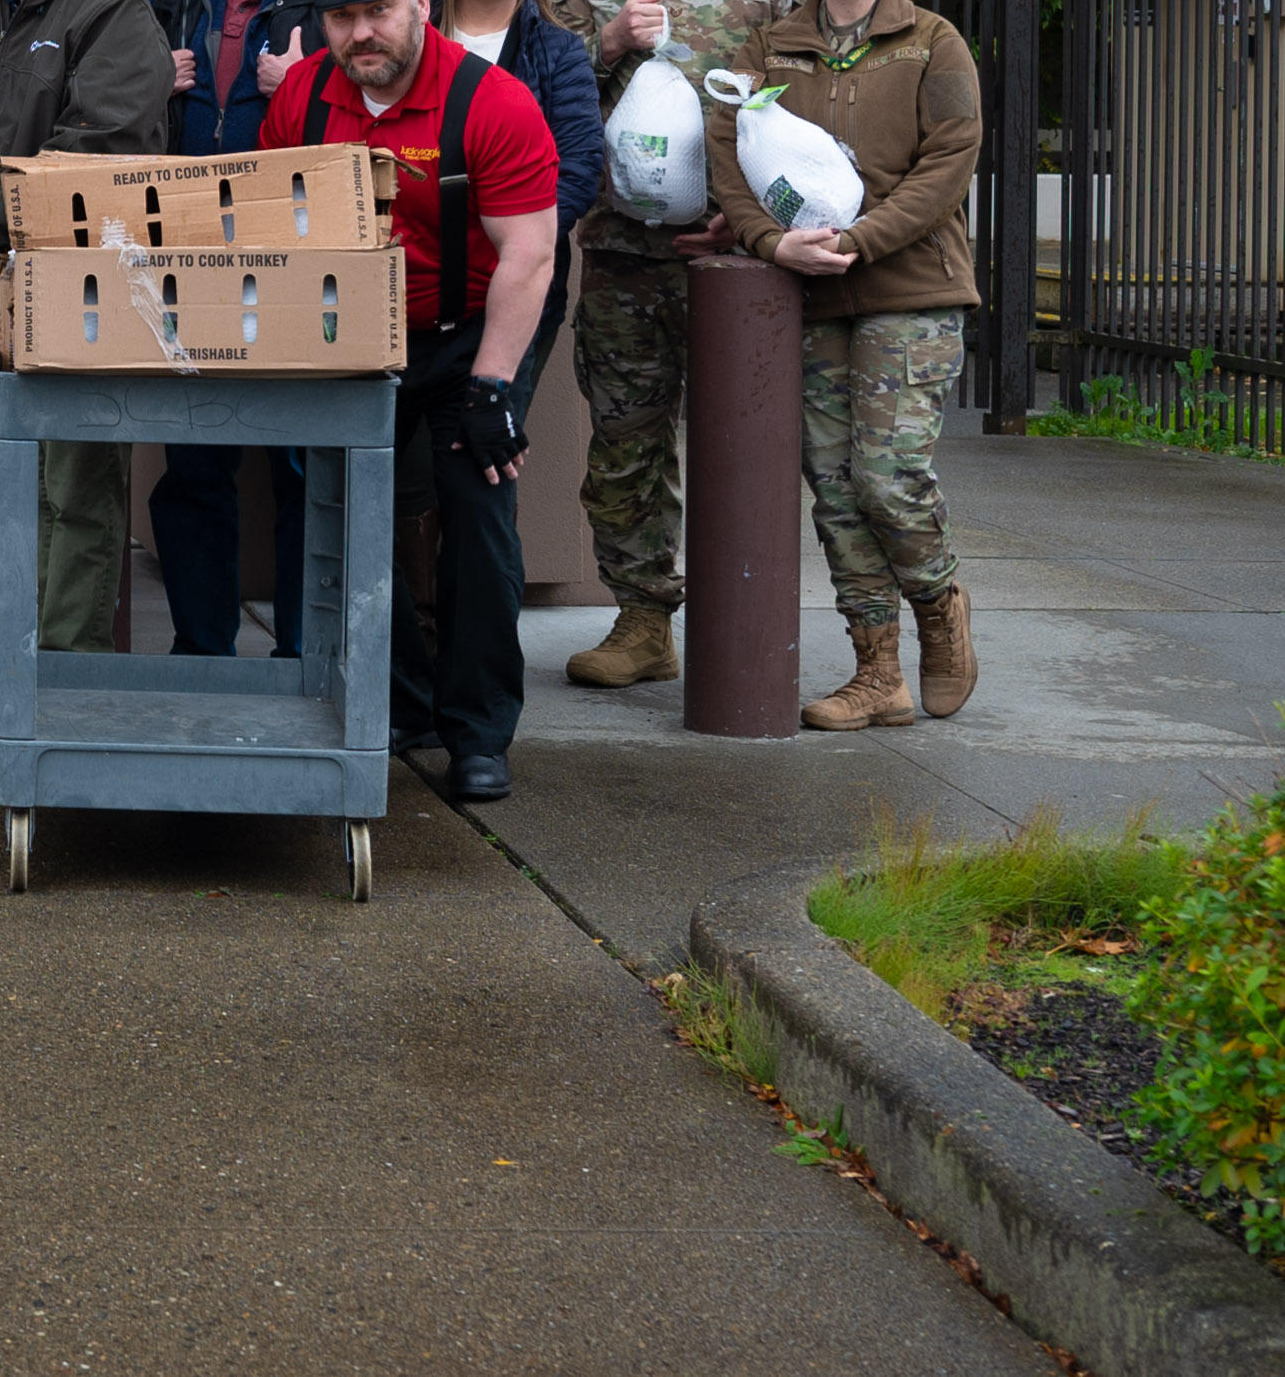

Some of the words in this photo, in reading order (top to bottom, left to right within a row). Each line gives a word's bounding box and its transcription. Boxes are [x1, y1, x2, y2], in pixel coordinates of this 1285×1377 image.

[113, 172, 152, 186] READY
[155, 169, 171, 182] TO
[175, 166, 209, 180] COOK
[211, 160, 259, 176] TURKEY
[352, 154, 363, 197] PRODUCT
[11, 184, 20, 212] U.S.A.
[356, 199, 365, 212] OF
[13, 215, 23, 228] OF
[357, 215, 367, 243] U.S.A.
[24, 258, 33, 287] U.S.A.
[132, 254, 174, 268] READY
[177, 254, 194, 268] TO
[198, 254, 234, 268] COOK
[238, 254, 289, 268] TURKEY
[389, 256, 397, 304] PRODUCT
[24, 289, 33, 303] OF
[390, 306, 397, 320] OF
[25, 305, 33, 353] PRODUCT
[390, 323, 398, 353] U.S.A.
[174, 348, 248, 361] PERISHABLE
